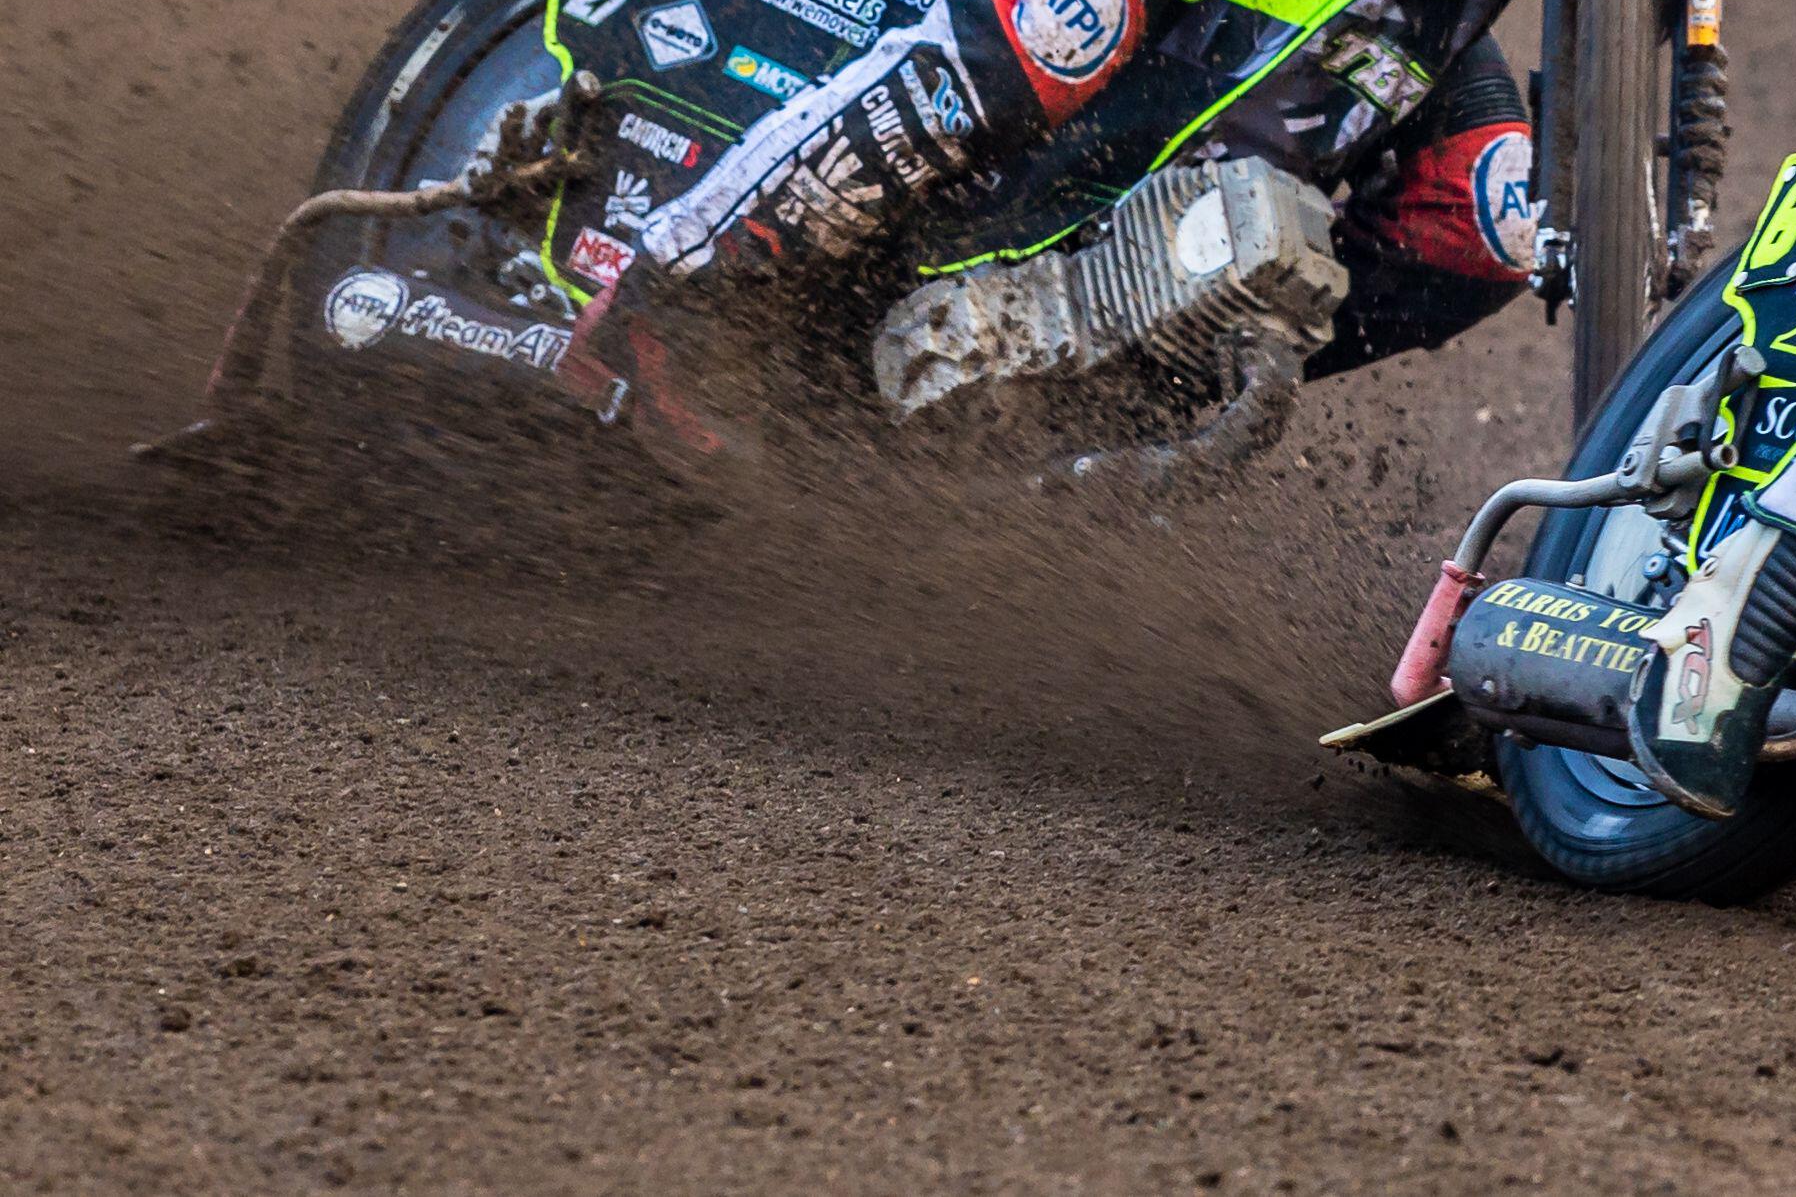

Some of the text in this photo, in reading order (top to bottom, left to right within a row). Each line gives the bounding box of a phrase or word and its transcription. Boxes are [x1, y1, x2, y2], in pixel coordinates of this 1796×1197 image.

[1483, 582, 1599, 622] HARRIS
[1496, 620, 1645, 673] & BEATTIE
[1671, 617, 1713, 736] TCX
